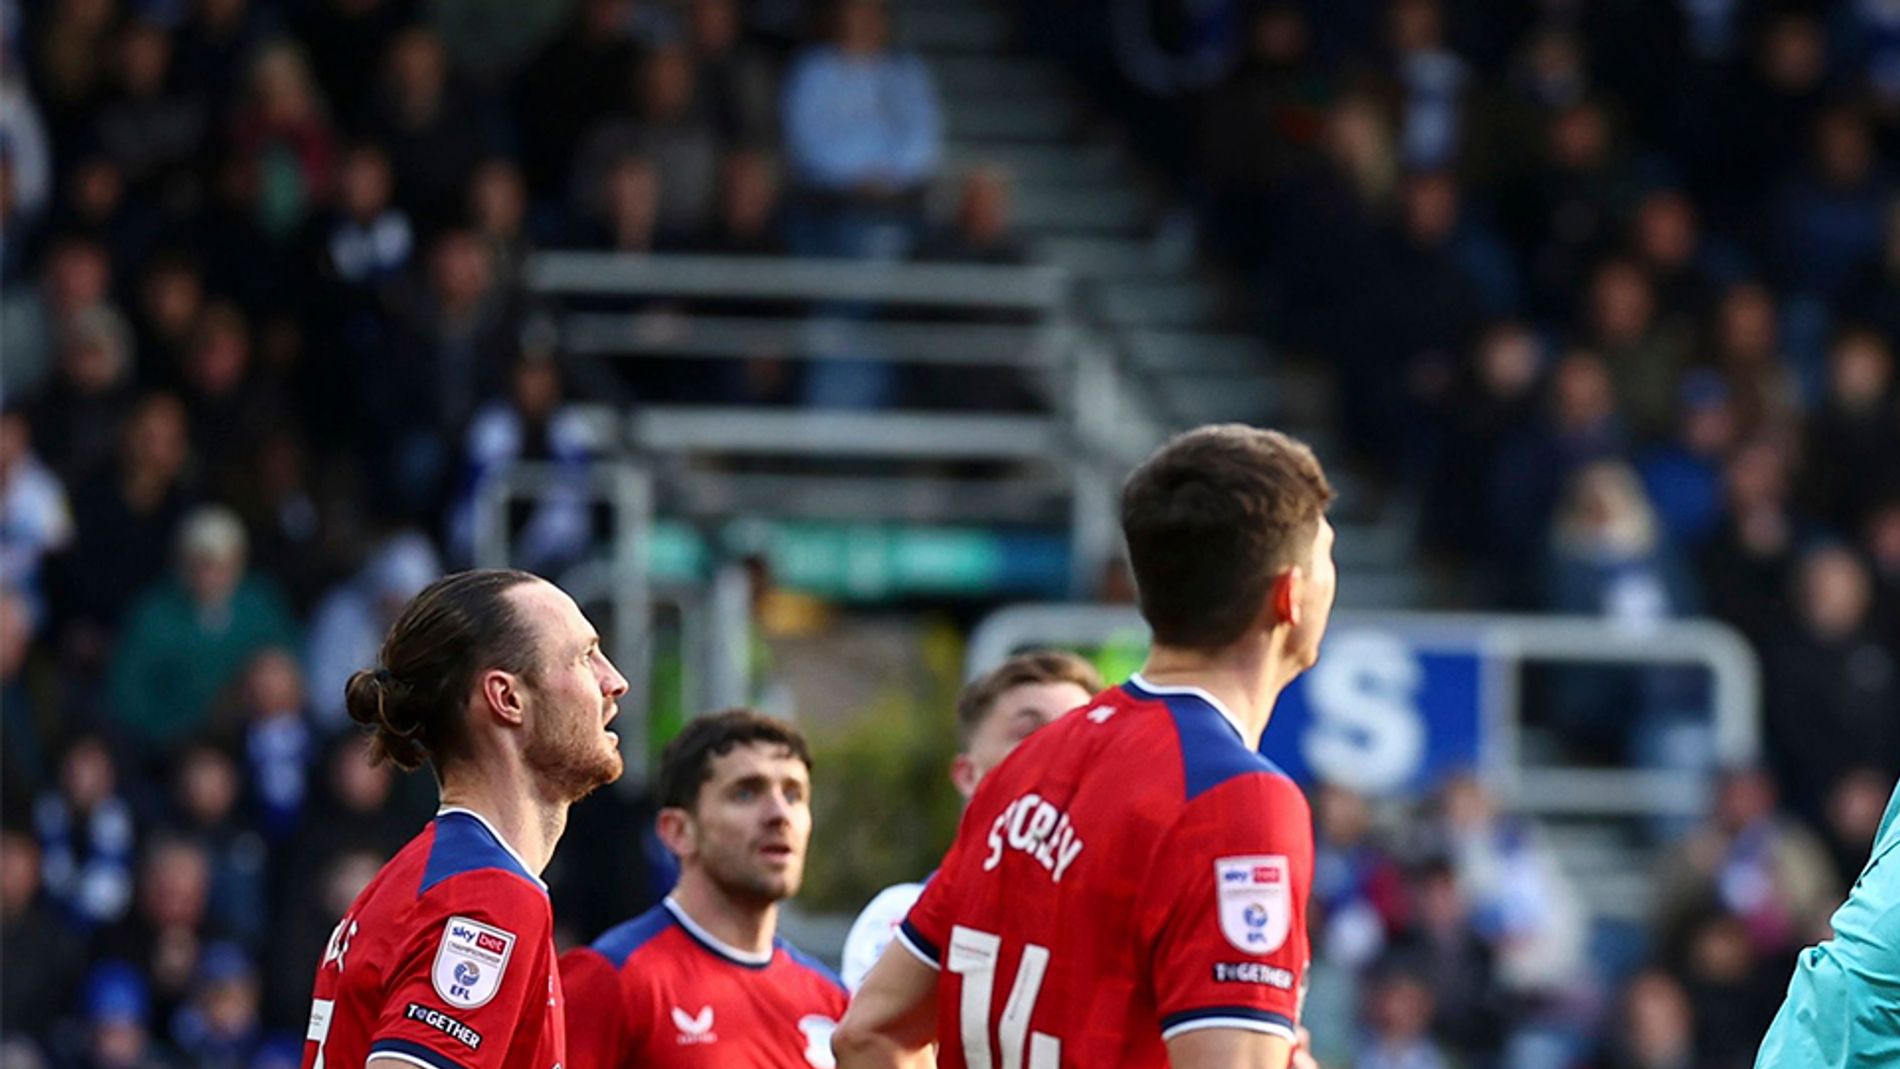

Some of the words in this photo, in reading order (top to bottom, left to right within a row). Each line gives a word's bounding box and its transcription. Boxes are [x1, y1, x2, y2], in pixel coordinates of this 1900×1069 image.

[1304, 632, 1425, 790] S
[452, 926, 476, 942] sky
[479, 934, 504, 951] bet
[450, 984, 471, 1001] EFL
[407, 1003, 481, 1049] TOGETHER
